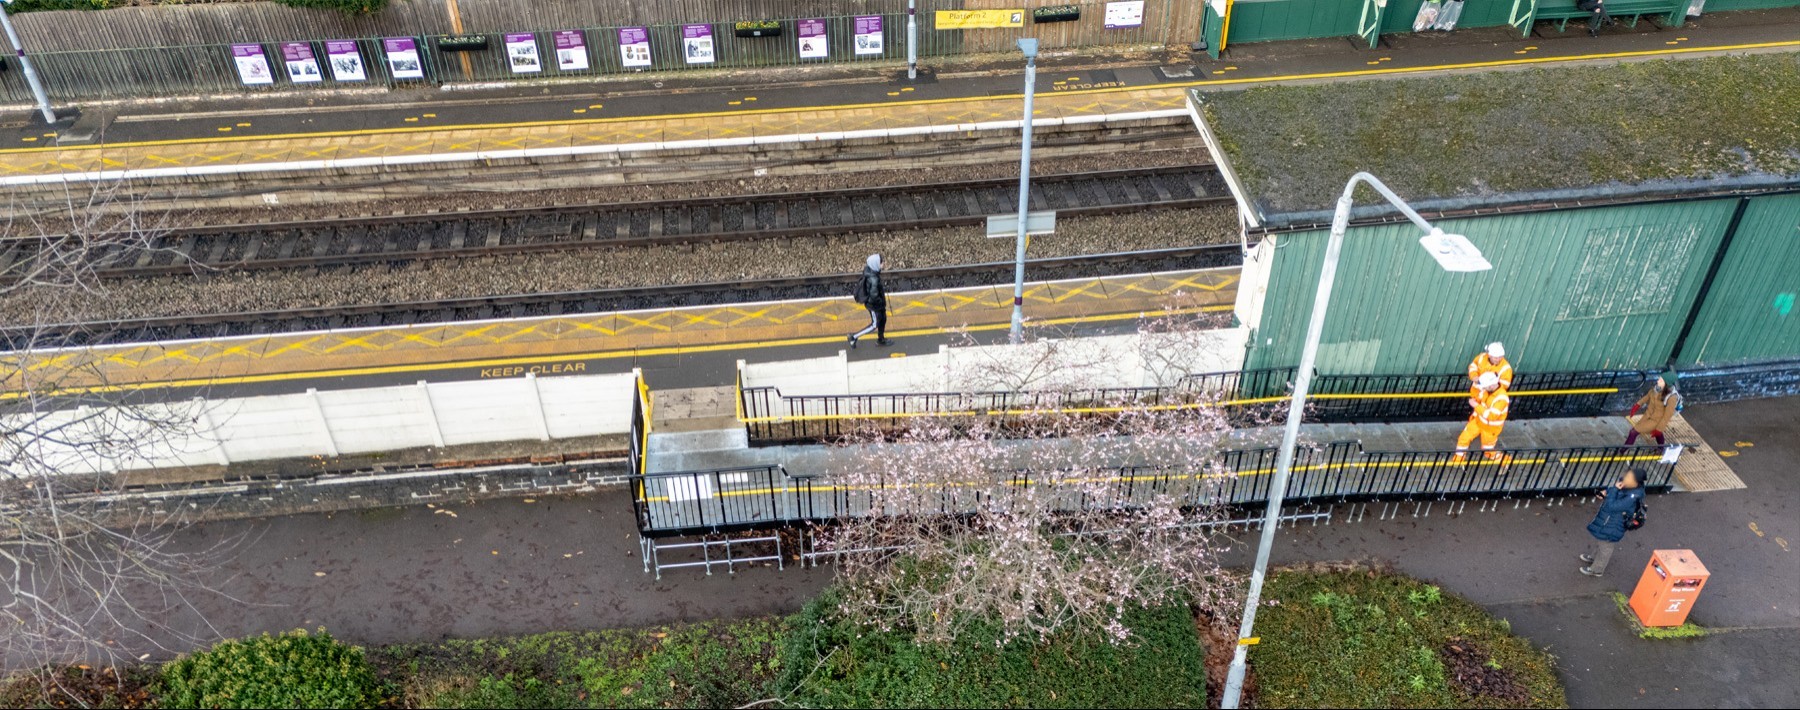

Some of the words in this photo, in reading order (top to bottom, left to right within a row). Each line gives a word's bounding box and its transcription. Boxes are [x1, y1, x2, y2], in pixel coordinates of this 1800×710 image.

[1053, 83, 1092, 91] CLEAR
[480, 366, 524, 378] KEEP
[530, 362, 586, 374] CLEAR
